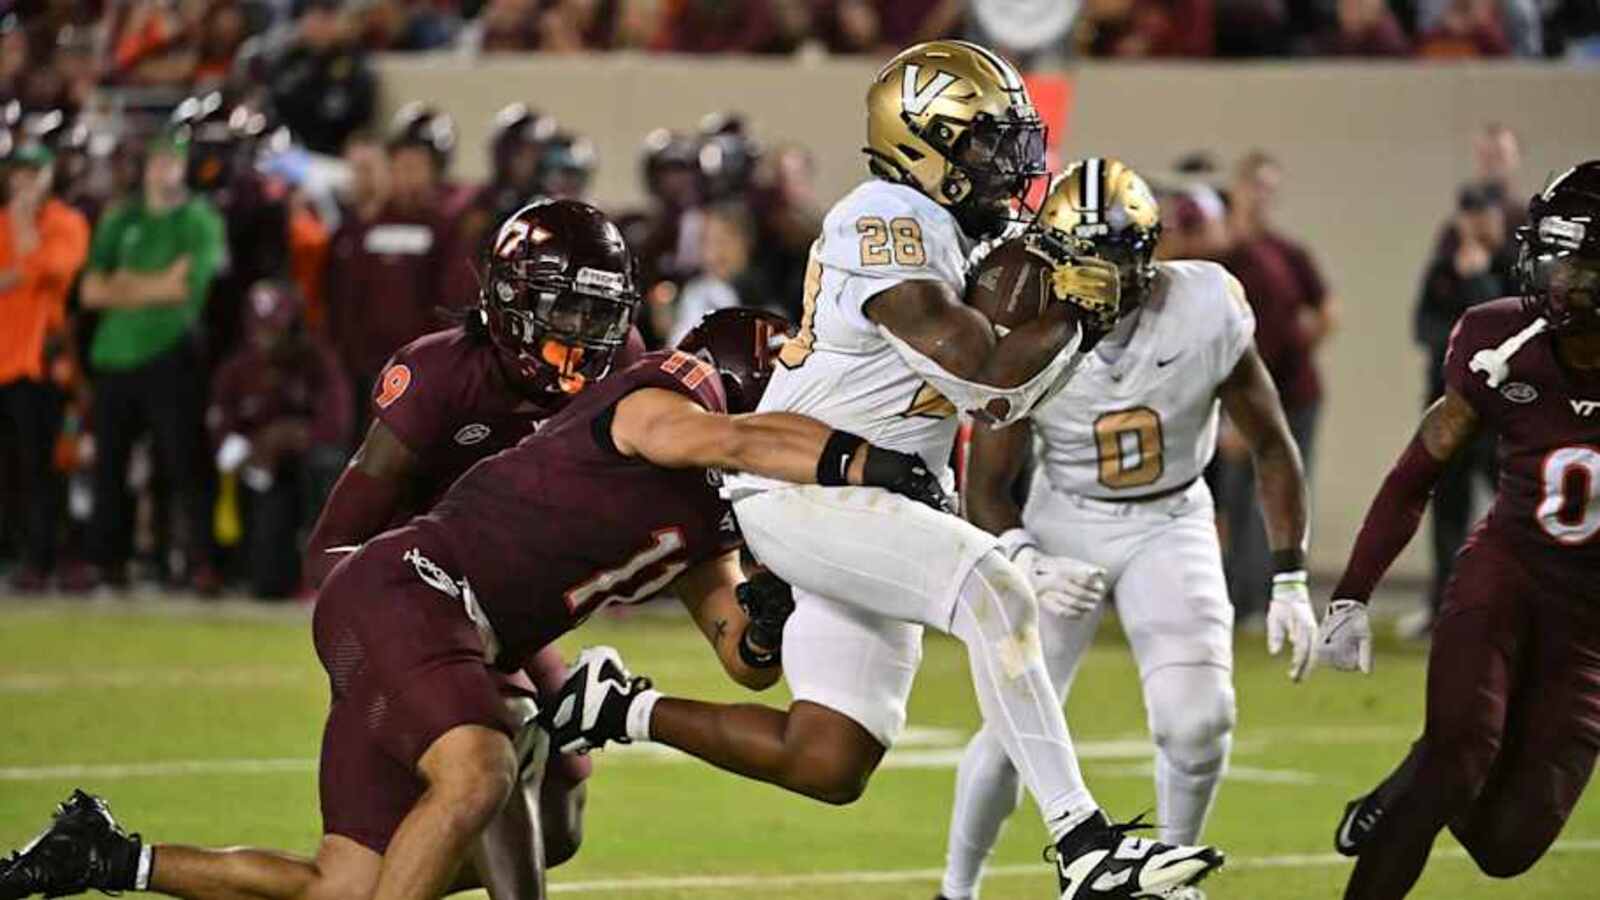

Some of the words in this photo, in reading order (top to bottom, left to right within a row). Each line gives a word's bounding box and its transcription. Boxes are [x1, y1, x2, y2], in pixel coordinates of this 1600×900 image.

[902, 64, 959, 116] V
[856, 216, 927, 267] 28
[375, 363, 412, 409] 9
[1095, 406, 1164, 489] 0
[1536, 446, 1600, 544] 0
